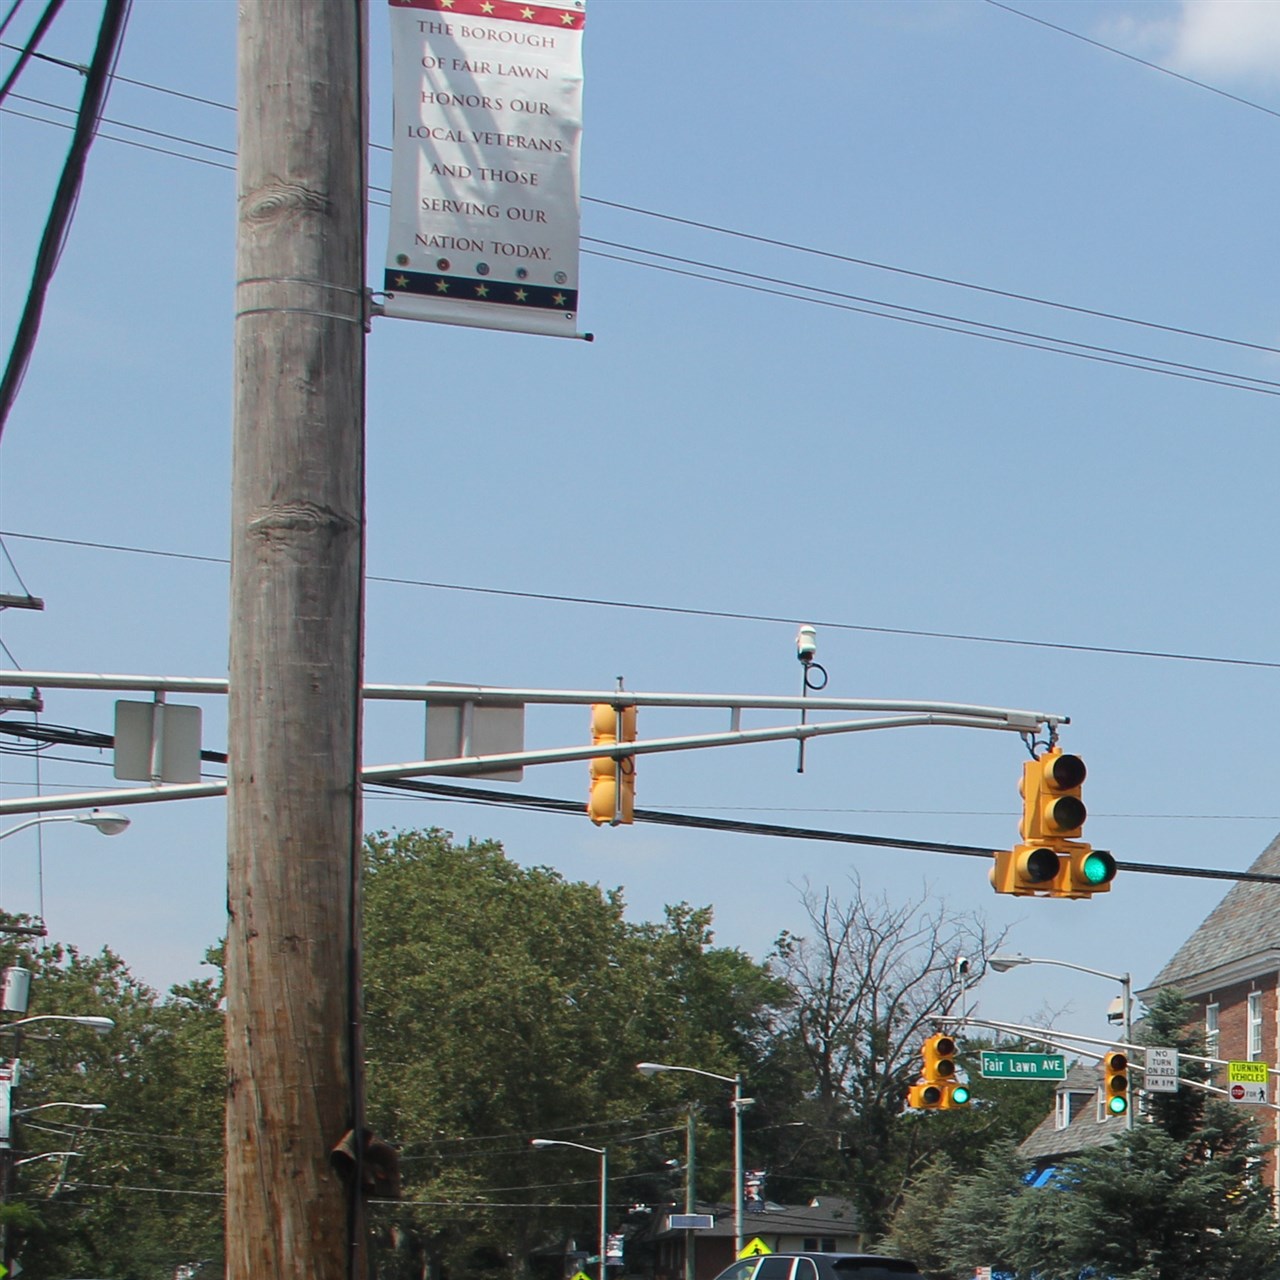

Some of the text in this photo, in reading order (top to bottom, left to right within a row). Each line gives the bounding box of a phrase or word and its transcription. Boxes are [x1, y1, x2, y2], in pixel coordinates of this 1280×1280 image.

[417, 19, 556, 49] THE BOROUGH
[421, 55, 550, 81] OF FAIR LAWN
[420, 91, 551, 116] HONORS OUR
[407, 125, 563, 153] LOCAL VETERANS
[429, 163, 539, 187] AND THOSE
[421, 197, 548, 224] SERVING OUR
[414, 233, 552, 261] NATION TODAY.
[983, 1058, 1004, 1072] Fair
[1009, 1059, 1038, 1073] Lawn
[1160, 1067, 1176, 1075] RED
[1231, 1063, 1265, 1073] TURNING
[1231, 1073, 1265, 1083] VEHICLES
